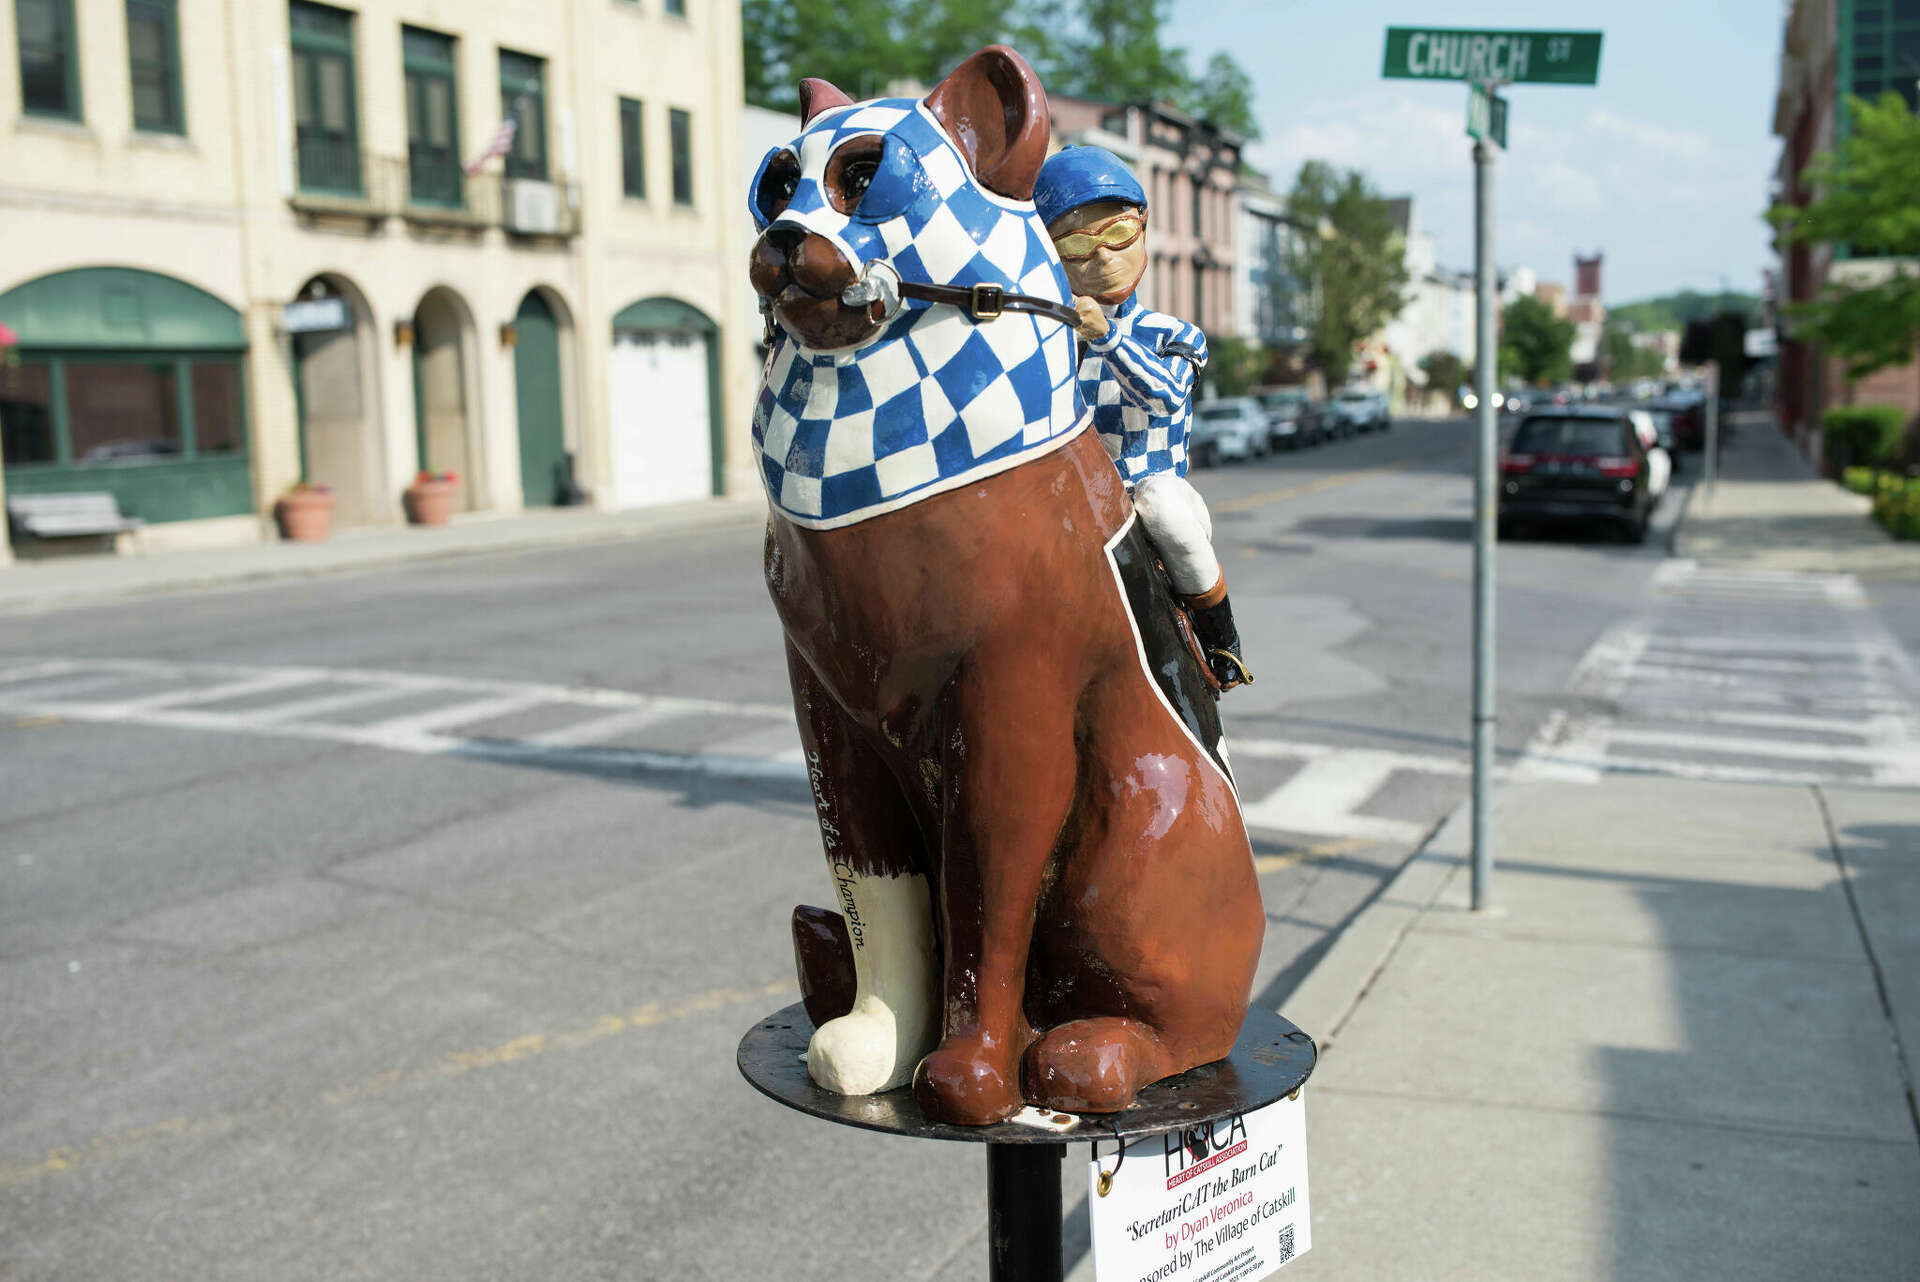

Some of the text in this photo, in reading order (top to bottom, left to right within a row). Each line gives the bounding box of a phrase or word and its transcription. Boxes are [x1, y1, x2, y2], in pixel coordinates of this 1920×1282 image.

[1407, 33, 1573, 79] CHURCH ST
[808, 751, 867, 951] Heart of a Champion
[1167, 1142, 1247, 1189] HEART OF CATSKILL ASSOCIATION
[1212, 1176, 1229, 1198] the
[1231, 1167, 1257, 1188] Barn
[1165, 1191, 1254, 1251] by Dyan Veronica
[1179, 1250, 1193, 1270] by
[1194, 1238, 1214, 1259] The
[1215, 1218, 1249, 1246] Village
[1250, 1205, 1261, 1226] of
[1262, 1186, 1296, 1219] Catskill
